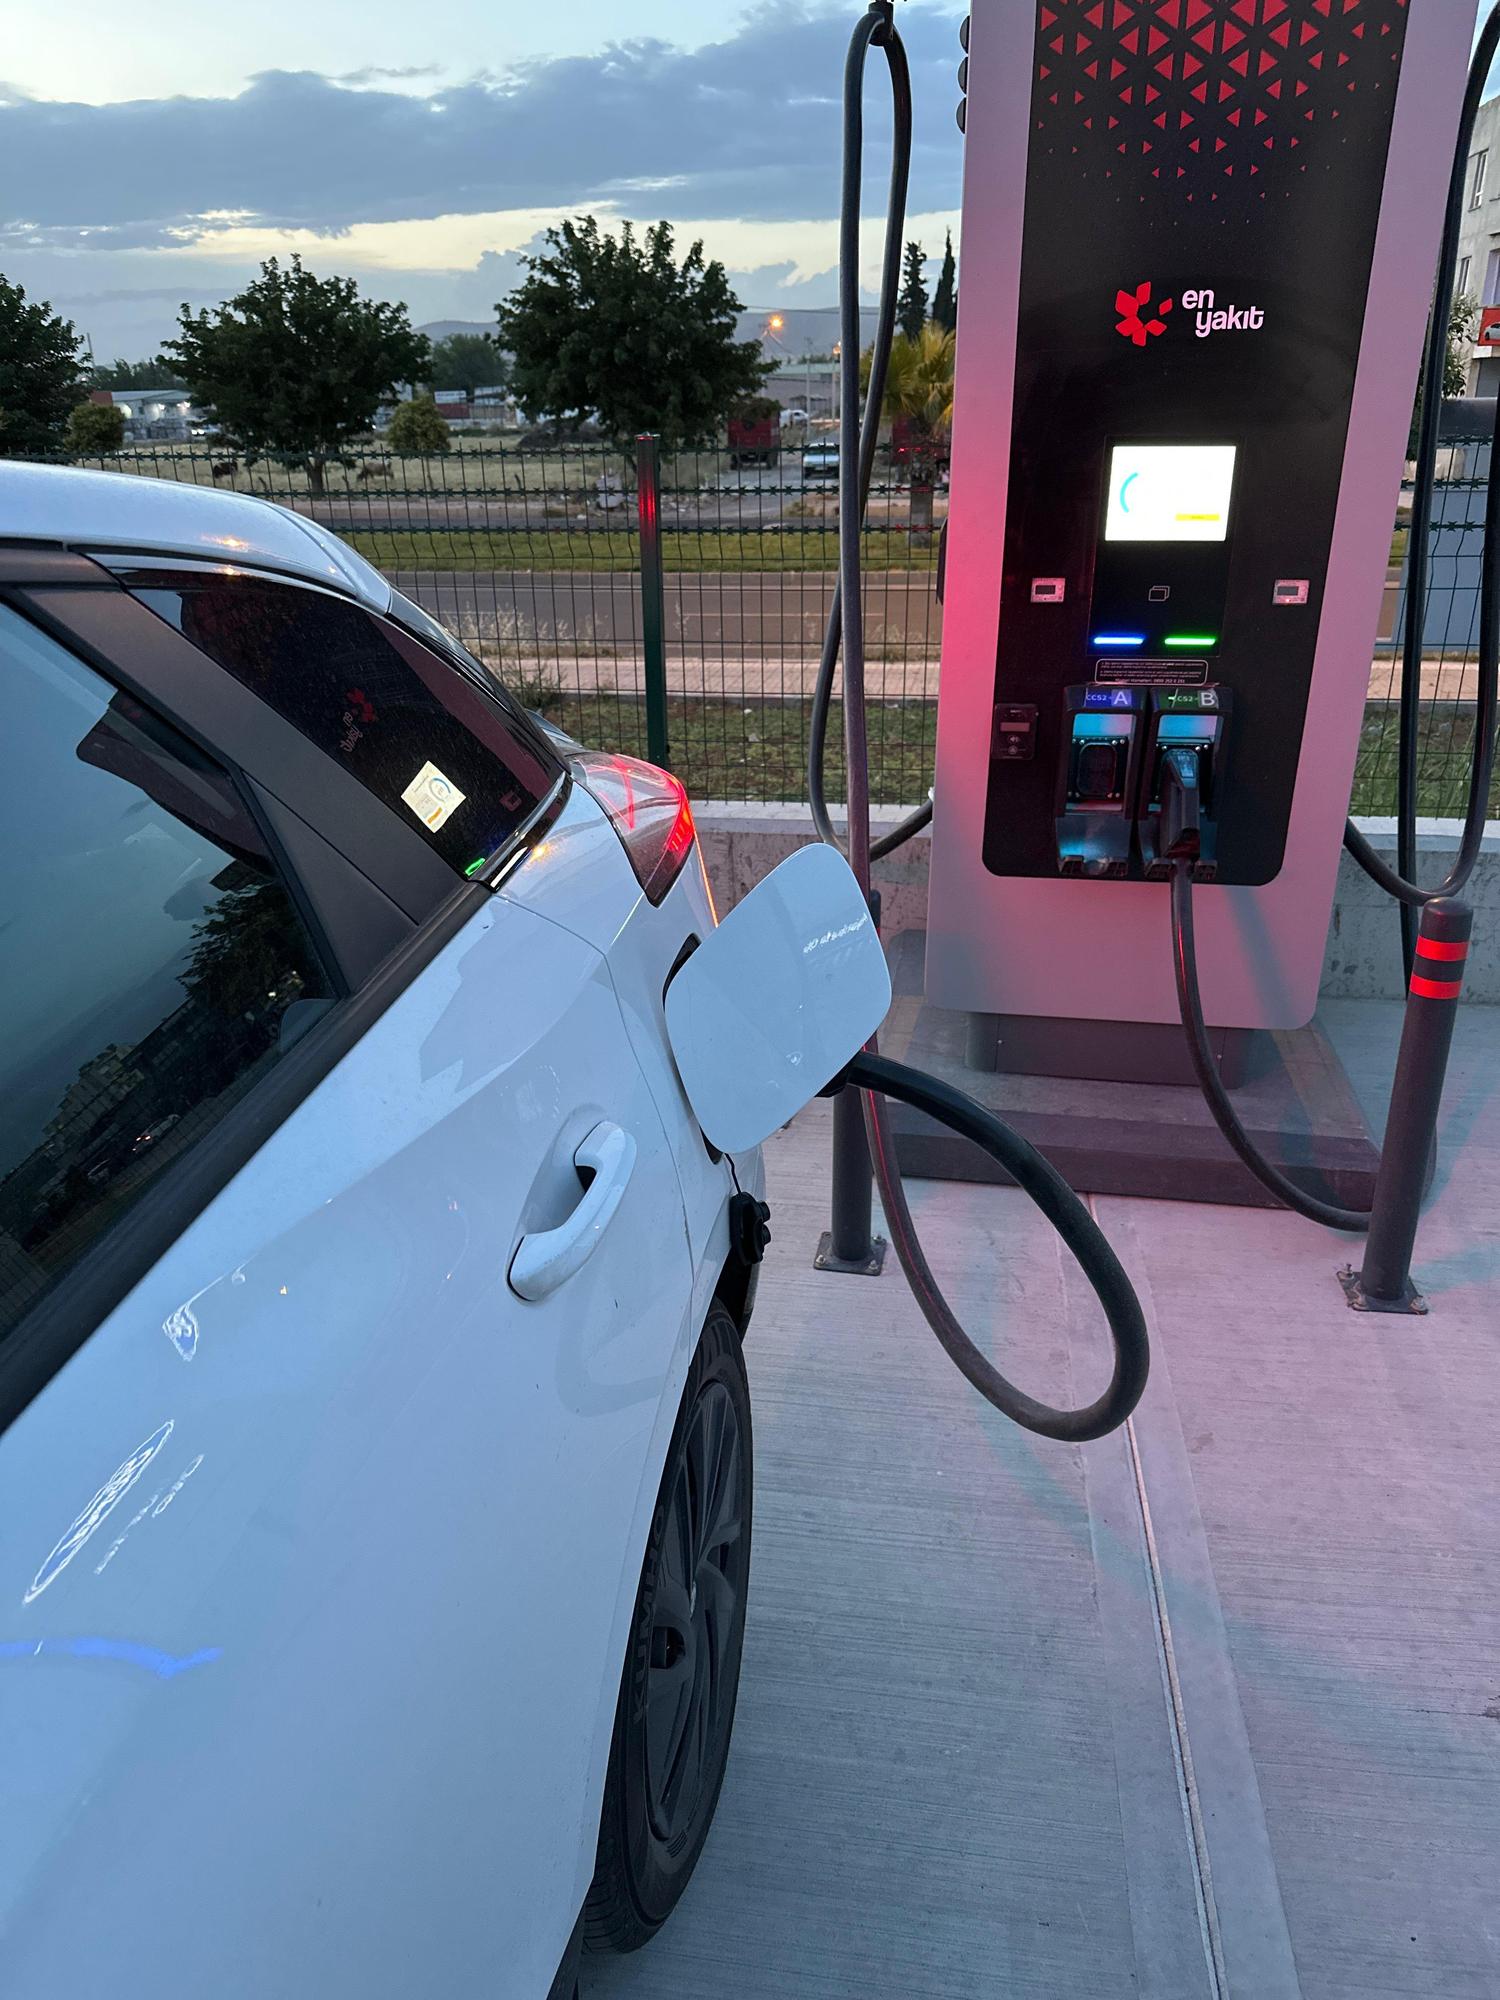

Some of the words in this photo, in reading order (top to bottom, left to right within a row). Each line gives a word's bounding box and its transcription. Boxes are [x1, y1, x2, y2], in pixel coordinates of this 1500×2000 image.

[1182, 289, 1214, 309] en
[1195, 305, 1264, 338] yakıt
[1113, 690, 1128, 705] A
[1201, 692, 1215, 706] B
[632, 1503, 664, 1724] KUMHO
